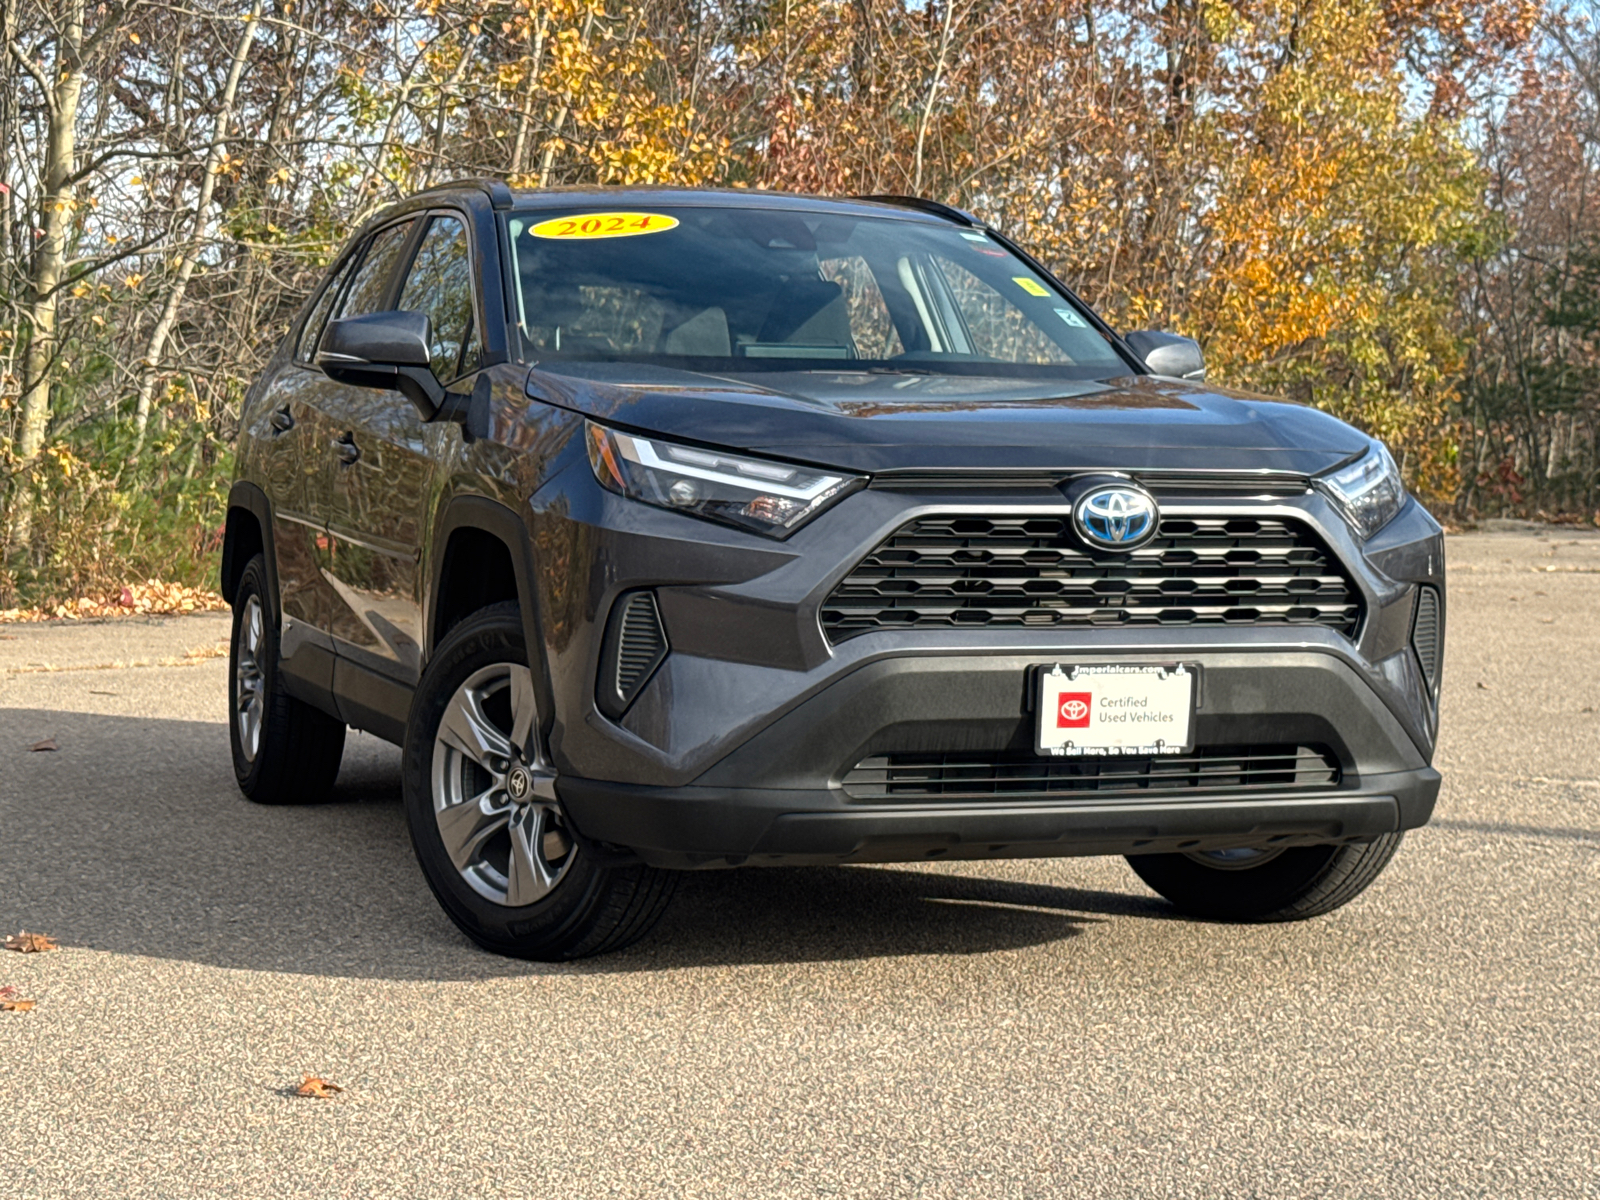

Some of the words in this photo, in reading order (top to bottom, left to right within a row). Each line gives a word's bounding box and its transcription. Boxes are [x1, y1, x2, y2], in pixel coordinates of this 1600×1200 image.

[557, 216, 652, 236] 2024
[1099, 696, 1148, 708] Certified
[1099, 711, 1127, 723] Used
[1130, 711, 1174, 723] Vehicles
[1051, 746, 1064, 756] We
[1066, 746, 1082, 756] Sell
[1120, 746, 1137, 756] You
[1138, 745, 1159, 755] Save
[1159, 745, 1181, 755] More
